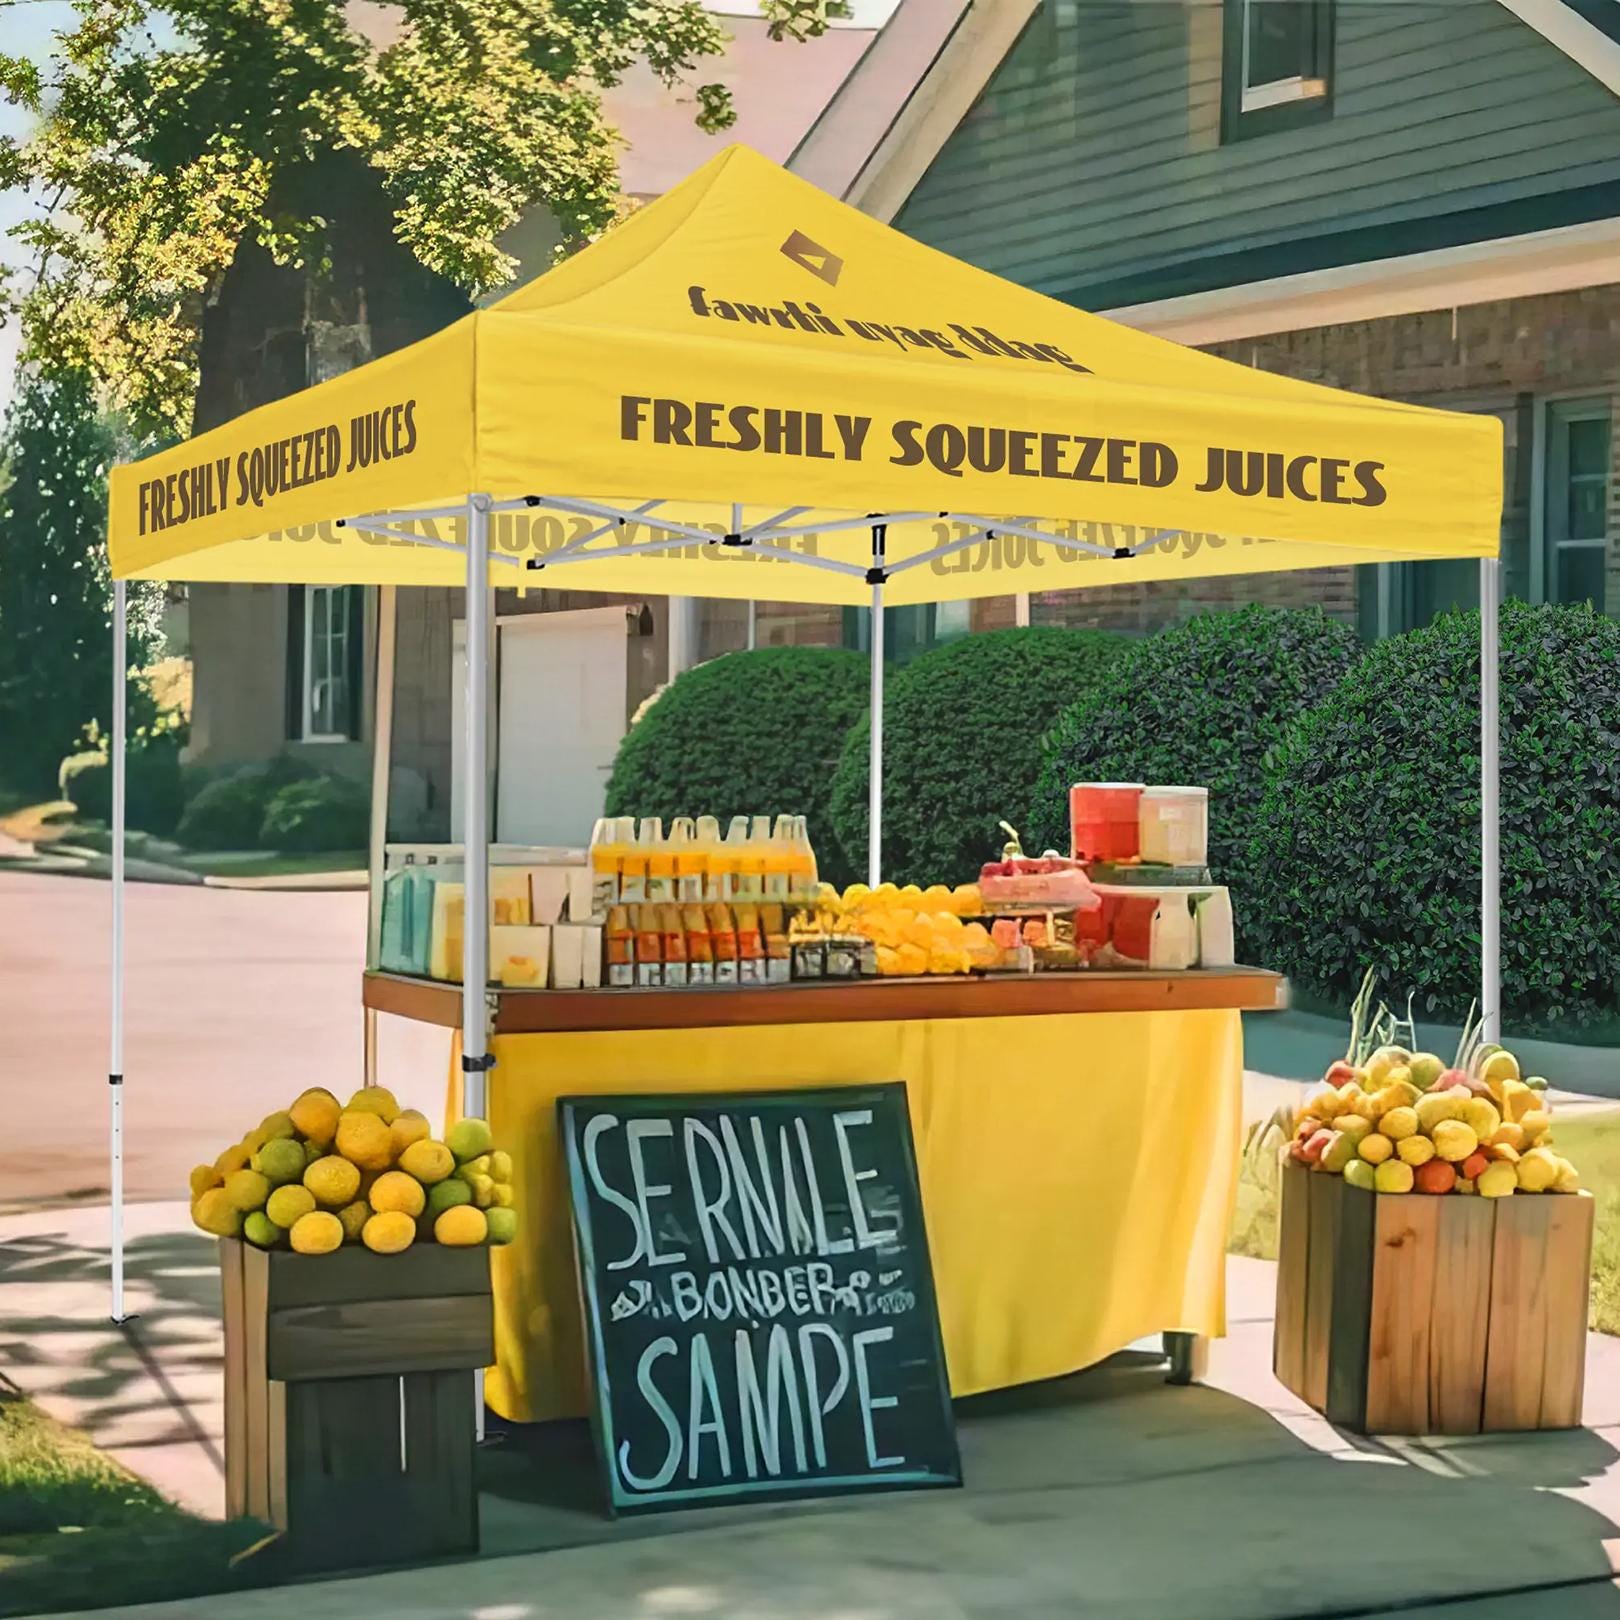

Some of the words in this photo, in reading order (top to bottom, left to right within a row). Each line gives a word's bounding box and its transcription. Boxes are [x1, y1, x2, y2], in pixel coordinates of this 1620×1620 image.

[139, 456, 231, 537] FRESHLY
[236, 424, 341, 508] SQUEEZED
[346, 399, 417, 473] JUICES
[621, 395, 872, 461] FRESHLY
[889, 420, 1179, 488] SQUEEZED
[1195, 447, 1387, 507] JUICES
[619, 1323, 906, 1491] SAMPE
